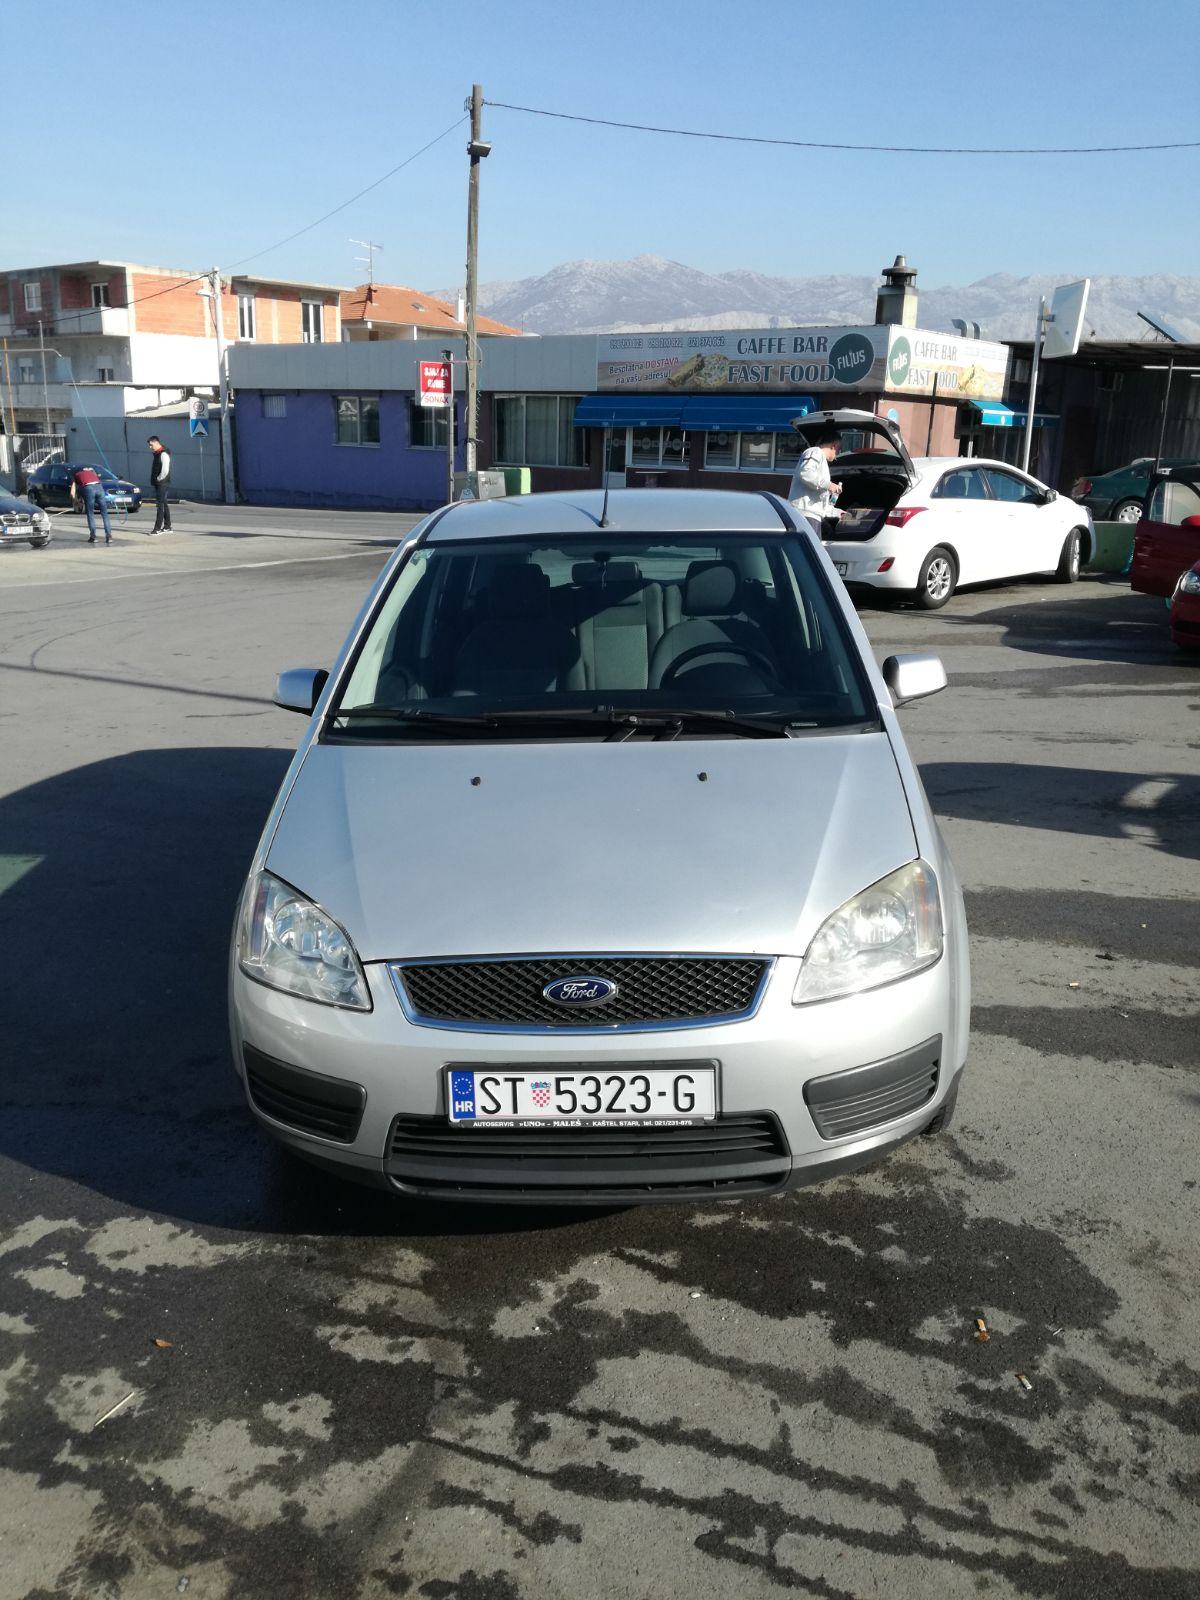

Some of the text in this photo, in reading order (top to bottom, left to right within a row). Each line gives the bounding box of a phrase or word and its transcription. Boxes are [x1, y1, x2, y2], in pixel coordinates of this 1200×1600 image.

[737, 335, 829, 355] CAFFE BAR
[914, 340, 940, 360] CAFFE
[941, 344, 958, 361] BAR
[609, 357, 679, 375] Besplatna DOSTAVA
[727, 364, 836, 384] FAST FOOD
[908, 367, 932, 386] FAST
[424, 395, 449, 404] SONAX
[560, 982, 598, 1000] Ford
[480, 1075, 696, 1115] ST 5323-G
[455, 1101, 474, 1113] HR
[553, 1119, 581, 1127] MALEŠ
[592, 1119, 618, 1127] KAŠTEL
